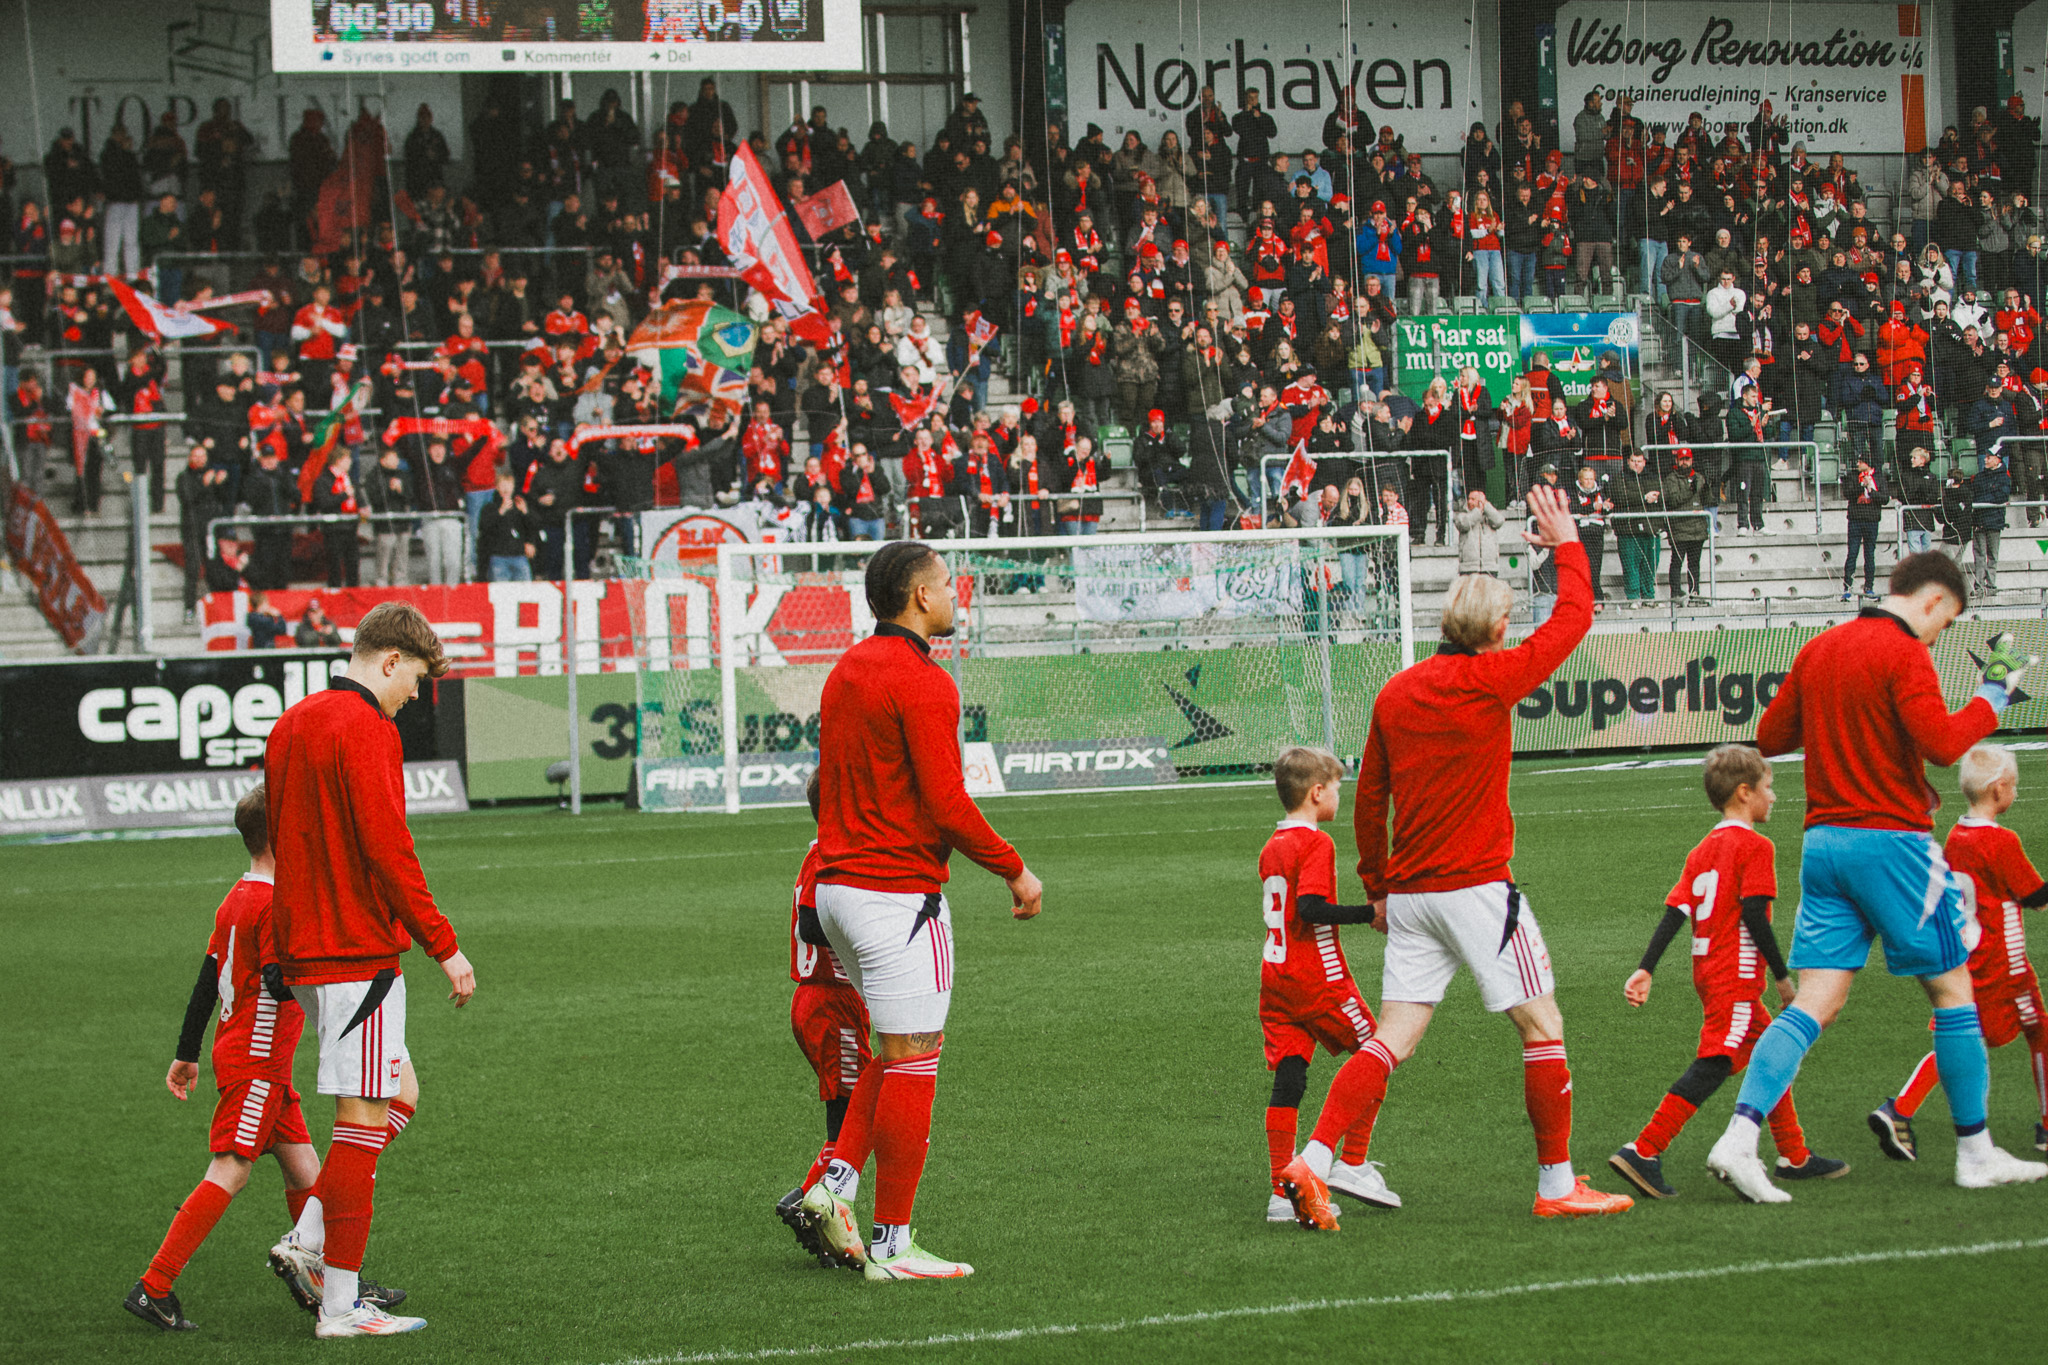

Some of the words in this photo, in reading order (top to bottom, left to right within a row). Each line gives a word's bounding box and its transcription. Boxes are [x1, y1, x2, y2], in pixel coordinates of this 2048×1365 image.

[343, 50, 394, 64] Synes
[401, 49, 438, 64] godt
[447, 53, 470, 62] om
[667, 50, 691, 62] Del
[1567, 16, 1687, 84] Viborg
[1691, 16, 1897, 67] Renovation
[1998, 39, 2009, 69] F
[1096, 38, 1452, 111] Nørhaven
[1592, 84, 1760, 105] Containerudlejning
[1785, 85, 1887, 102] Kranservice
[1404, 324, 1428, 348] Vi
[1432, 323, 1472, 346] har
[1476, 324, 1507, 346] sat
[1485, 351, 1513, 373] op
[1517, 656, 1791, 731] Superliga
[78, 658, 350, 760] capel
[1263, 875, 1288, 964] 9
